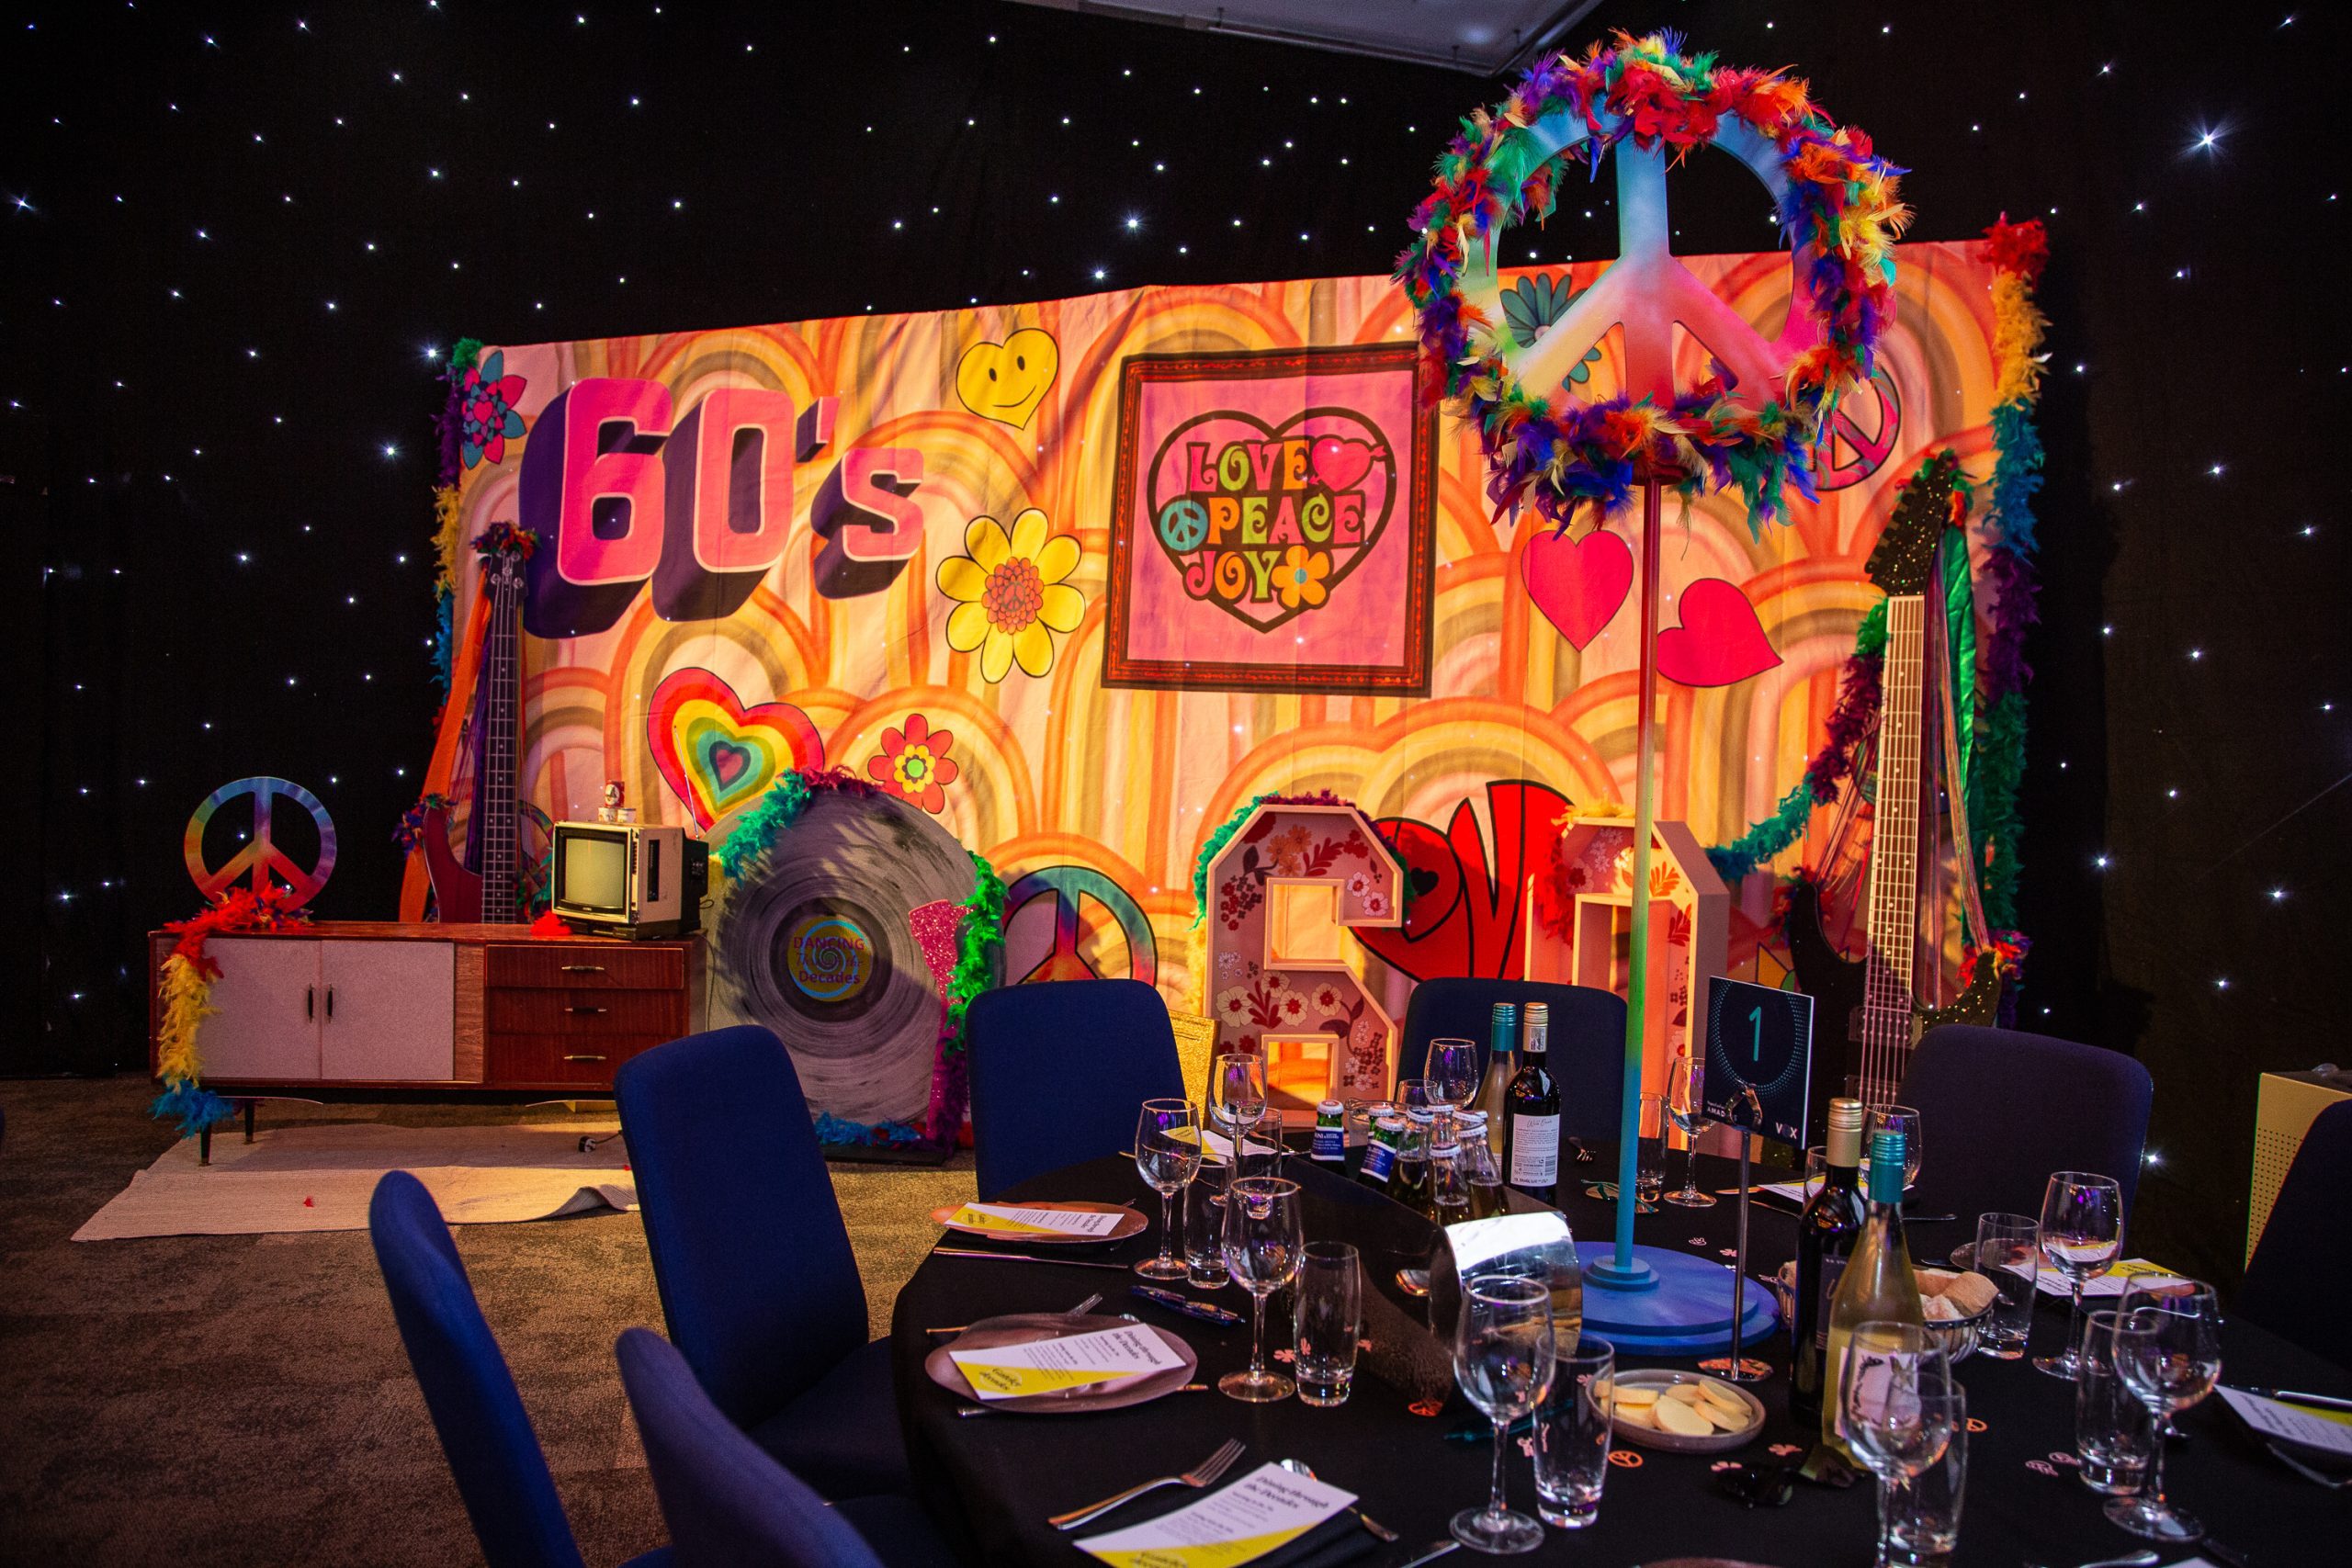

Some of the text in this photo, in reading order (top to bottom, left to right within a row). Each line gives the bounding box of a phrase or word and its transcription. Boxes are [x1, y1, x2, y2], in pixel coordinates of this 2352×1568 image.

[549, 378, 924, 595] 60's
[1187, 438, 1311, 493] LOVE
[1206, 493, 1363, 545] PEACE
[1185, 549, 1283, 600] JOY
[793, 936, 865, 951] DANCING
[798, 970, 861, 985] Decades
[1748, 1006, 1762, 1062] 1
[1775, 1122, 1798, 1140] VOX
